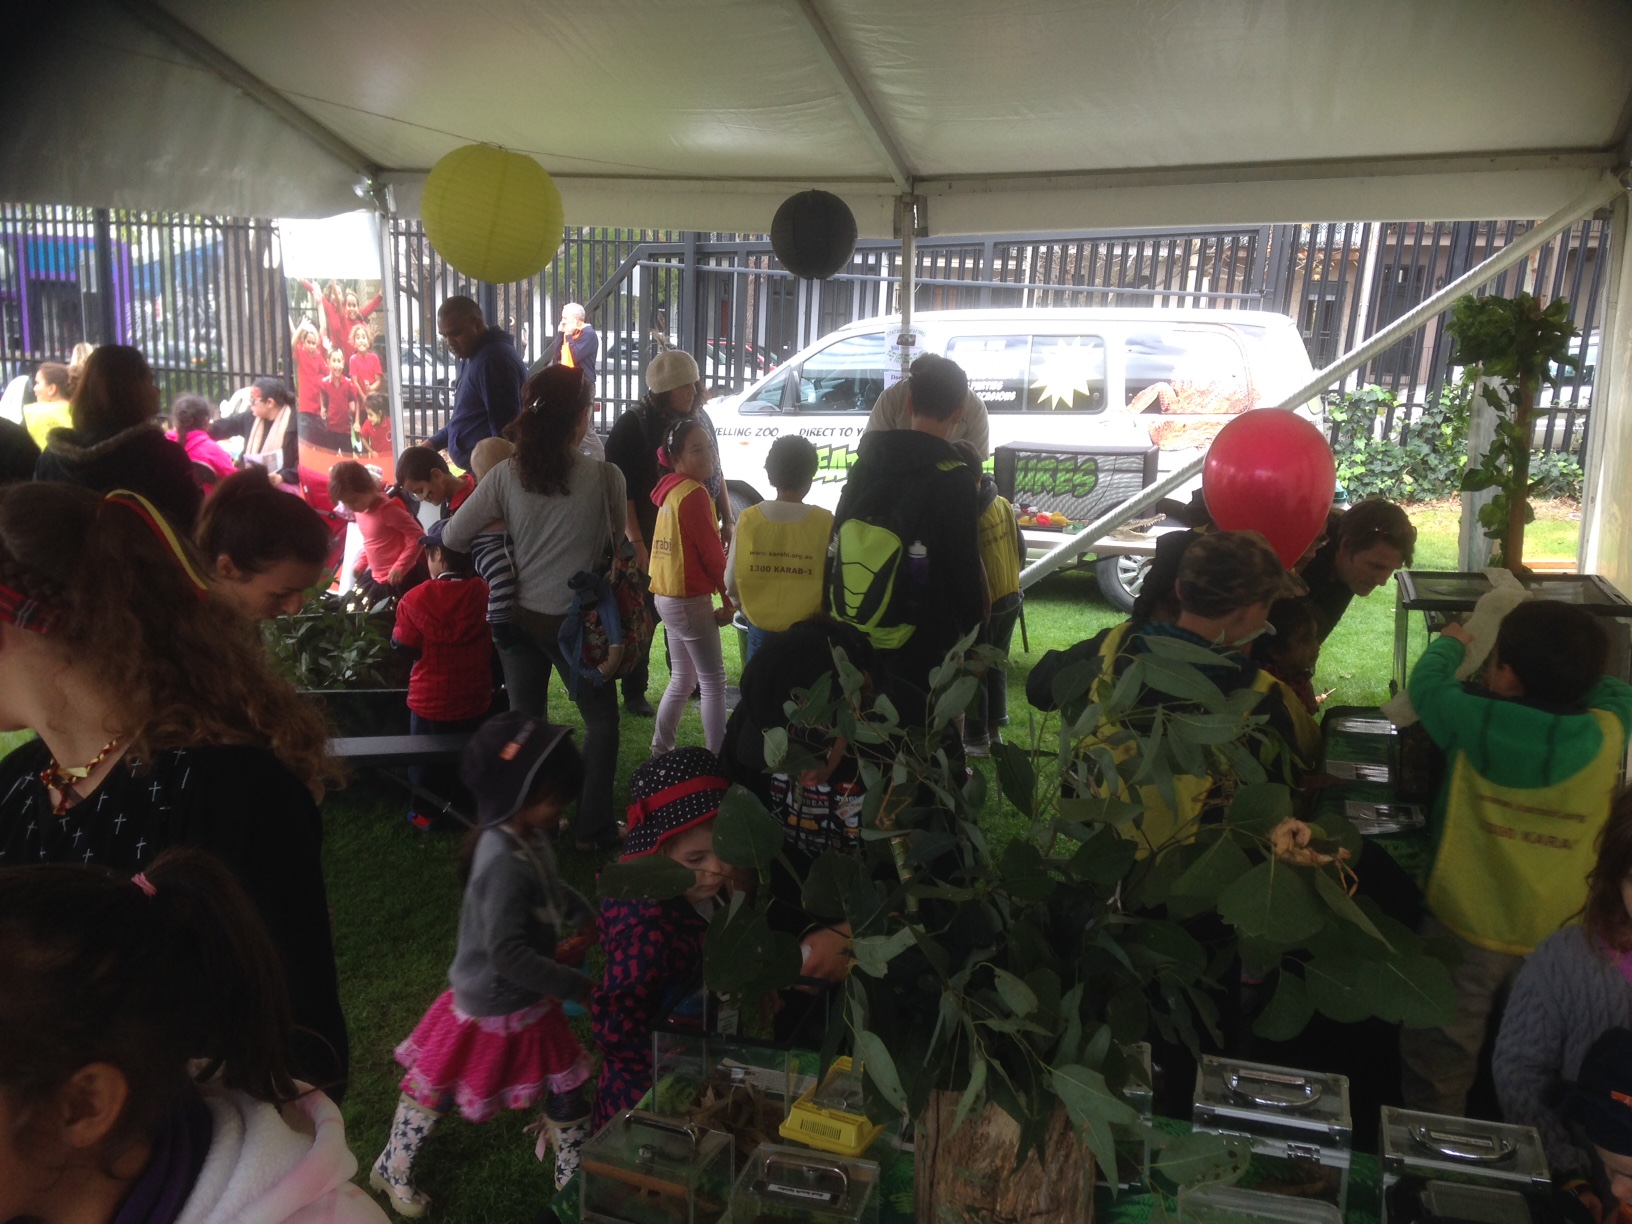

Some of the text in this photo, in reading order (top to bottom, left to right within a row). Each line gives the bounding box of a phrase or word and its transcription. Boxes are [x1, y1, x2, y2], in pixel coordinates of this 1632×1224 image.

[755, 427, 779, 437] ZOO
[799, 427, 836, 437] DIRECT
[839, 427, 853, 437] TO
[749, 564, 813, 575] 1300 KARAB-1
